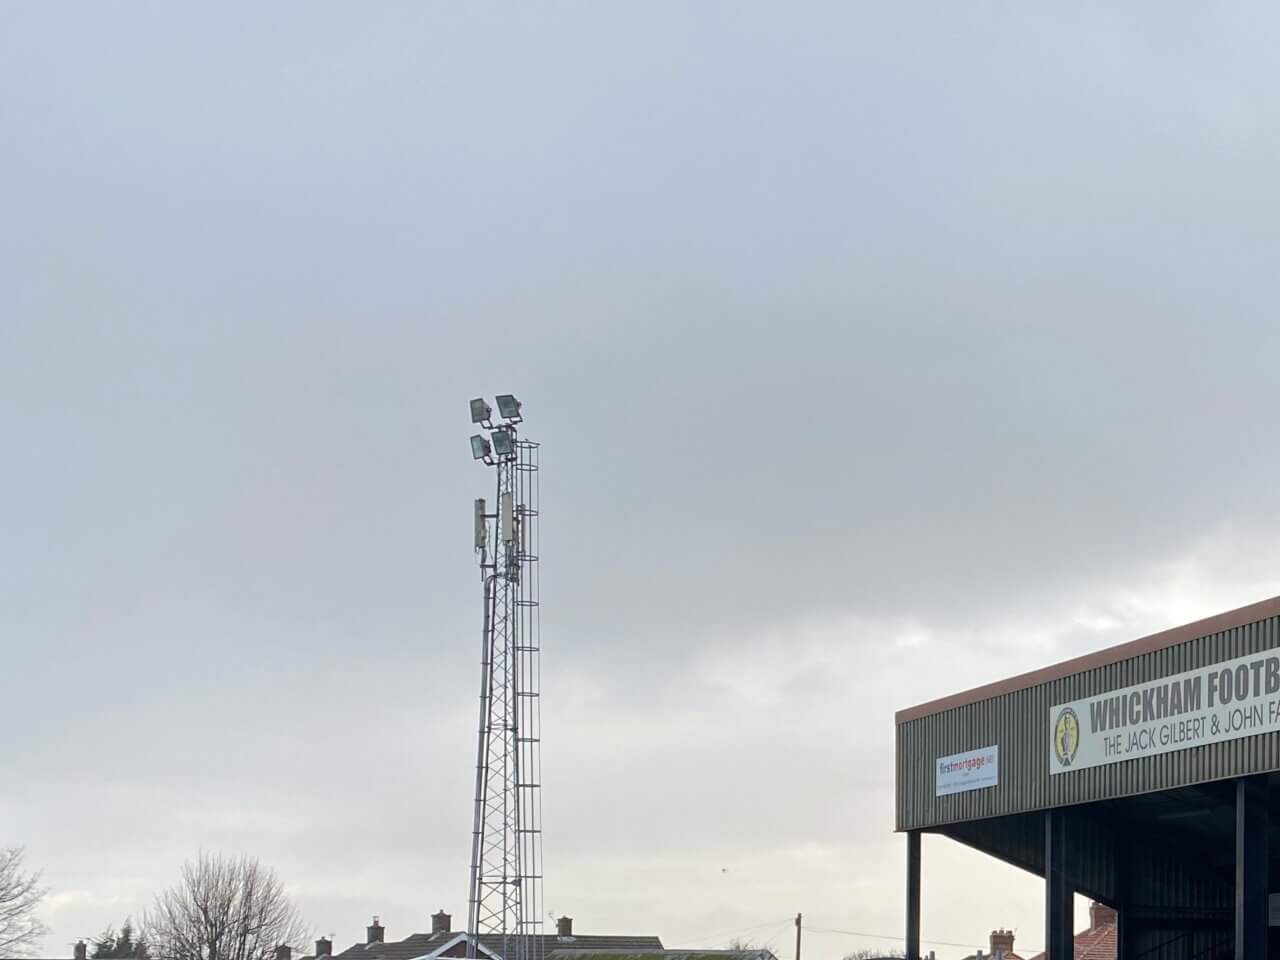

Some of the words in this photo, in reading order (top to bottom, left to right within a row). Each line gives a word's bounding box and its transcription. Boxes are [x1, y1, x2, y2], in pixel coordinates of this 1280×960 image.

[1089, 675, 1201, 734] WHICKHAM
[1103, 734, 1122, 757] THE
[1125, 727, 1157, 753] JACK
[1159, 716, 1207, 747] GILBERT
[1210, 714, 1220, 736] &
[1224, 702, 1264, 733] JOHN
